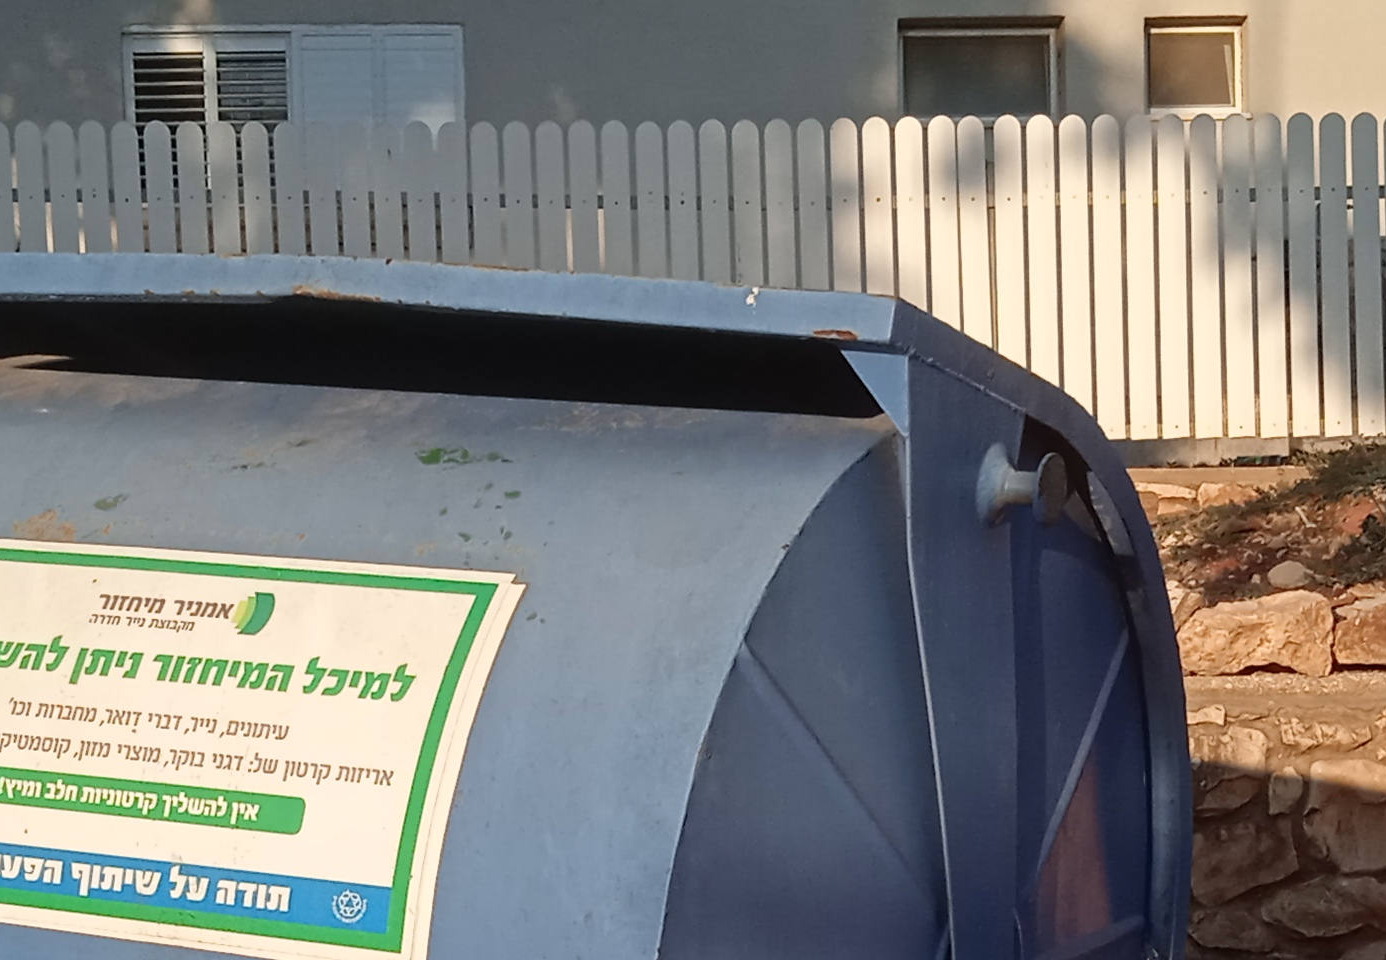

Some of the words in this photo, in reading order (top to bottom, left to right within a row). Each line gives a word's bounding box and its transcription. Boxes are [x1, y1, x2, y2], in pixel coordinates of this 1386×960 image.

[100, 593, 165, 614] מיחזור
[89, 613, 120, 626] חדרה
[126, 616, 145, 627] נייר
[148, 619, 195, 632] מקבוצת
[69, 646, 144, 685] ניתן
[152, 652, 295, 692] המיחזור
[302, 656, 417, 702] למיכל
[35, 701, 97, 723] מחברות
[148, 712, 183, 730] דברי
[184, 716, 218, 735] נייר,
[219, 720, 289, 740] עיתונים,
[73, 738, 111, 761] מזון,
[117, 743, 161, 764] מוצרי
[163, 749, 205, 771] בוקר,
[212, 752, 244, 772] דגני
[248, 752, 278, 774] של:
[282, 759, 331, 785] קרטון
[335, 765, 394, 786] אריזות
[44, 778, 78, 799] חלב
[80, 787, 158, 815] קרטוניות
[162, 791, 227, 818] להשליך
[230, 803, 260, 825] אין
[70, 862, 161, 897] שיתוף
[169, 865, 209, 901] על
[216, 879, 291, 912] תודה
